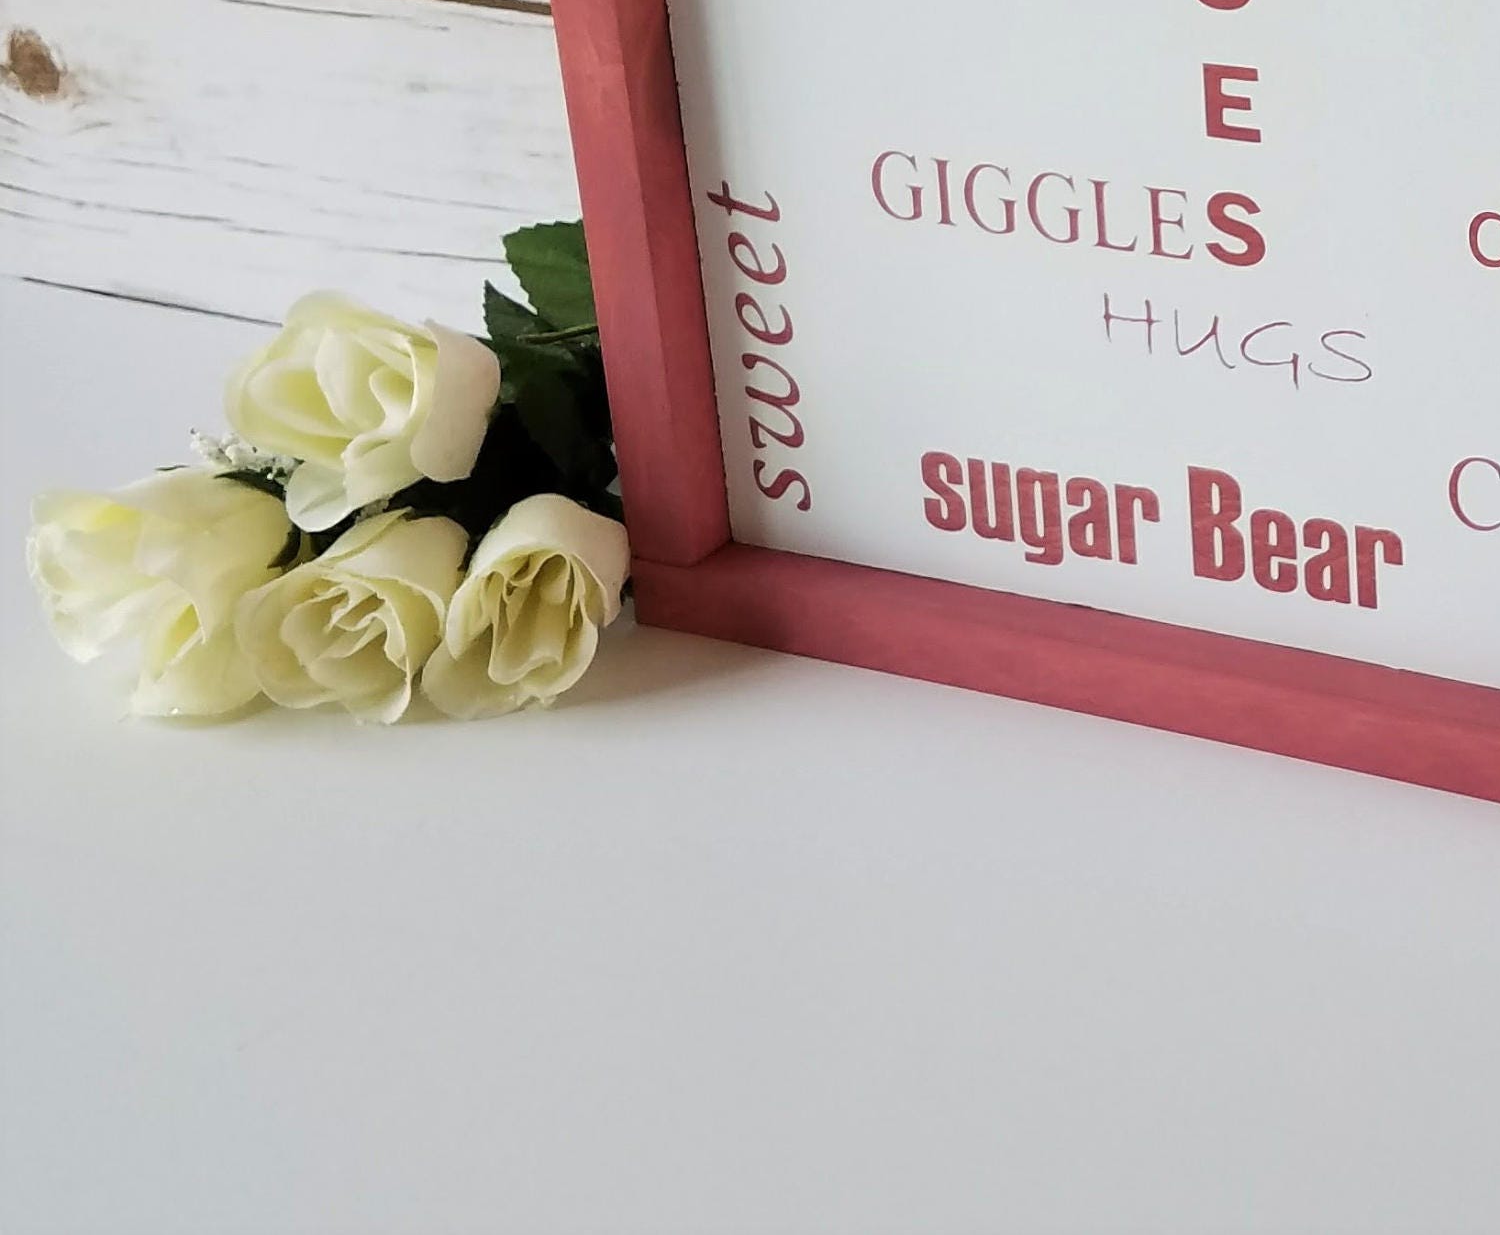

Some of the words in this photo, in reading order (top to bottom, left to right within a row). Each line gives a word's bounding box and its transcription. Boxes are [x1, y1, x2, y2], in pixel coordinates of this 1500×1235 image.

[870, 149, 1267, 268] GIGGLES
[707, 179, 812, 513] sweet
[1103, 292, 1374, 390] HUGS
[920, 450, 1160, 566] sugar
[1187, 465, 1405, 610] Bear
